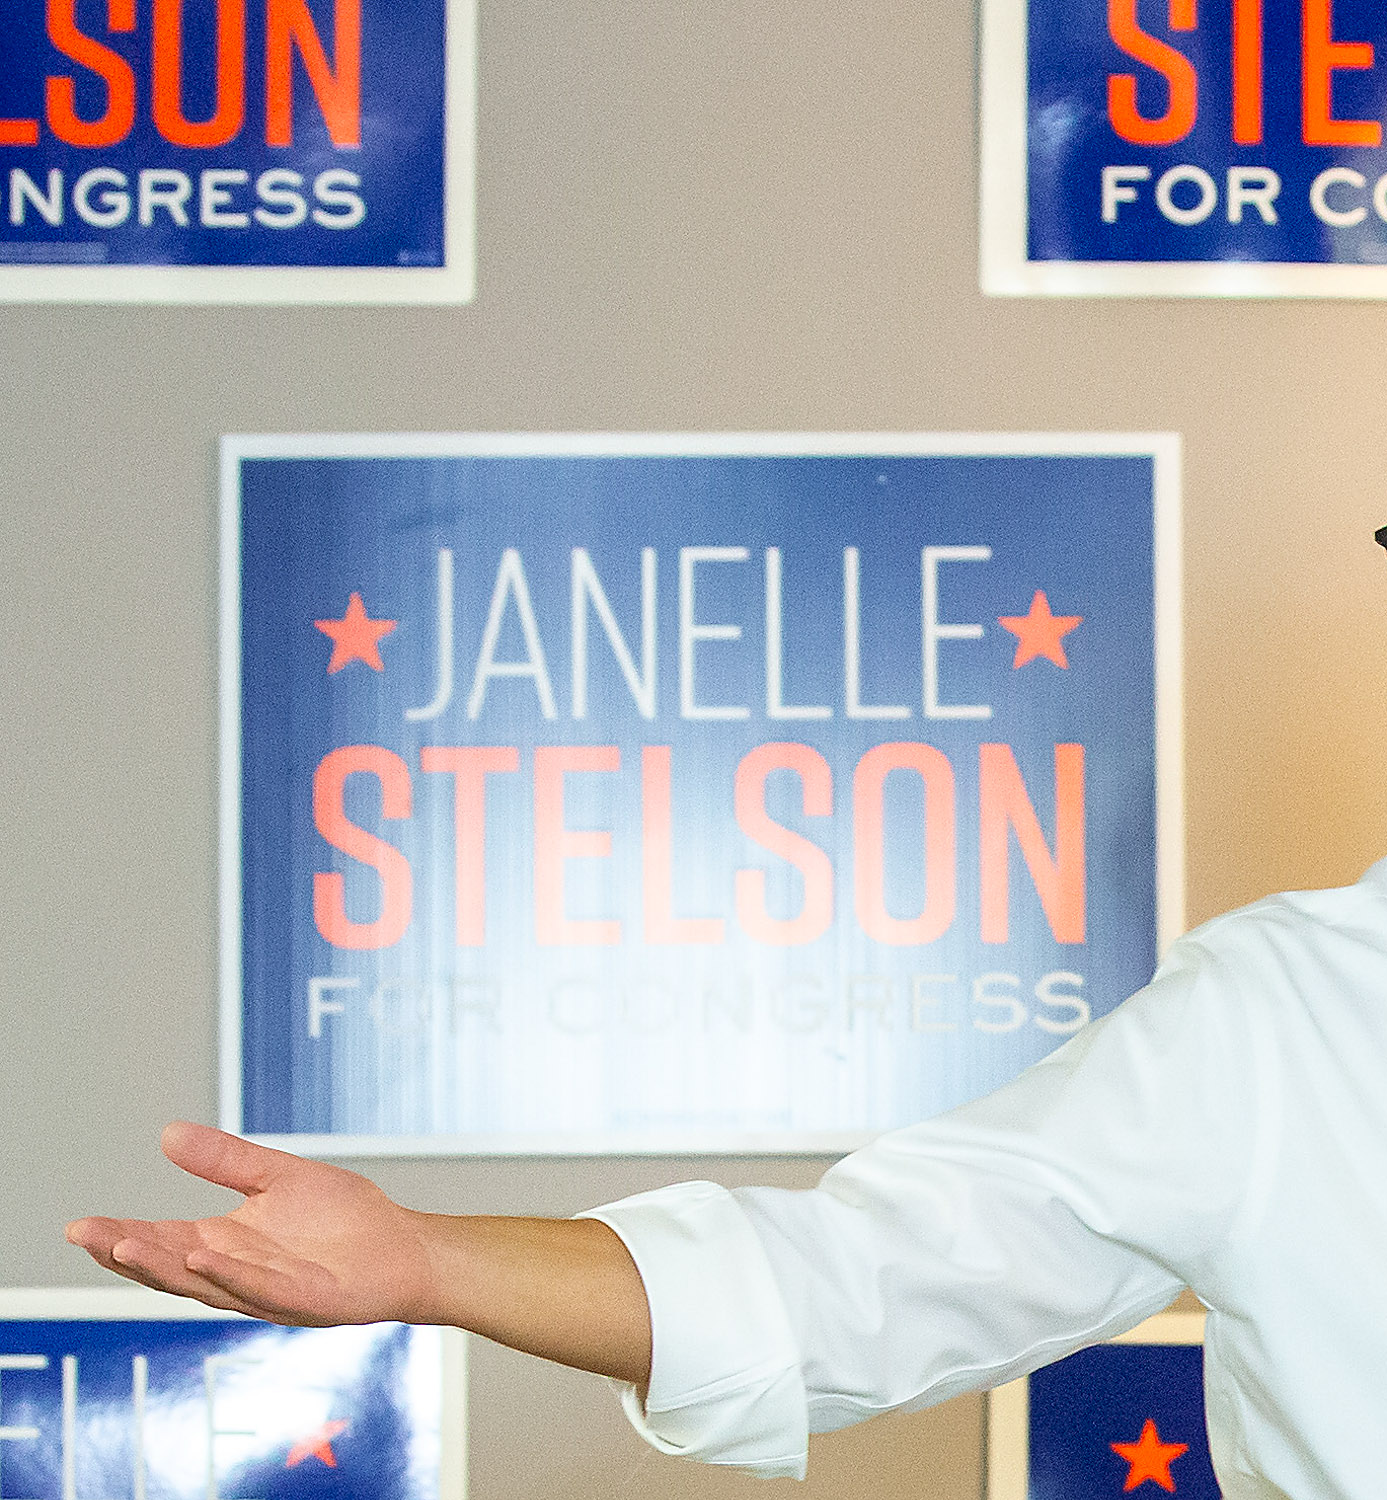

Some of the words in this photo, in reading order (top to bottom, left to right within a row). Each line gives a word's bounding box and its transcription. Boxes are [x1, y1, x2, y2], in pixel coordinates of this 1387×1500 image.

[1101, 164, 1281, 225] FOR
[403, 546, 993, 721] JANELLE
[312, 741, 1086, 950] STELSON
[306, 976, 504, 1037] FOR
[547, 970, 1092, 1036] CONGRESS
